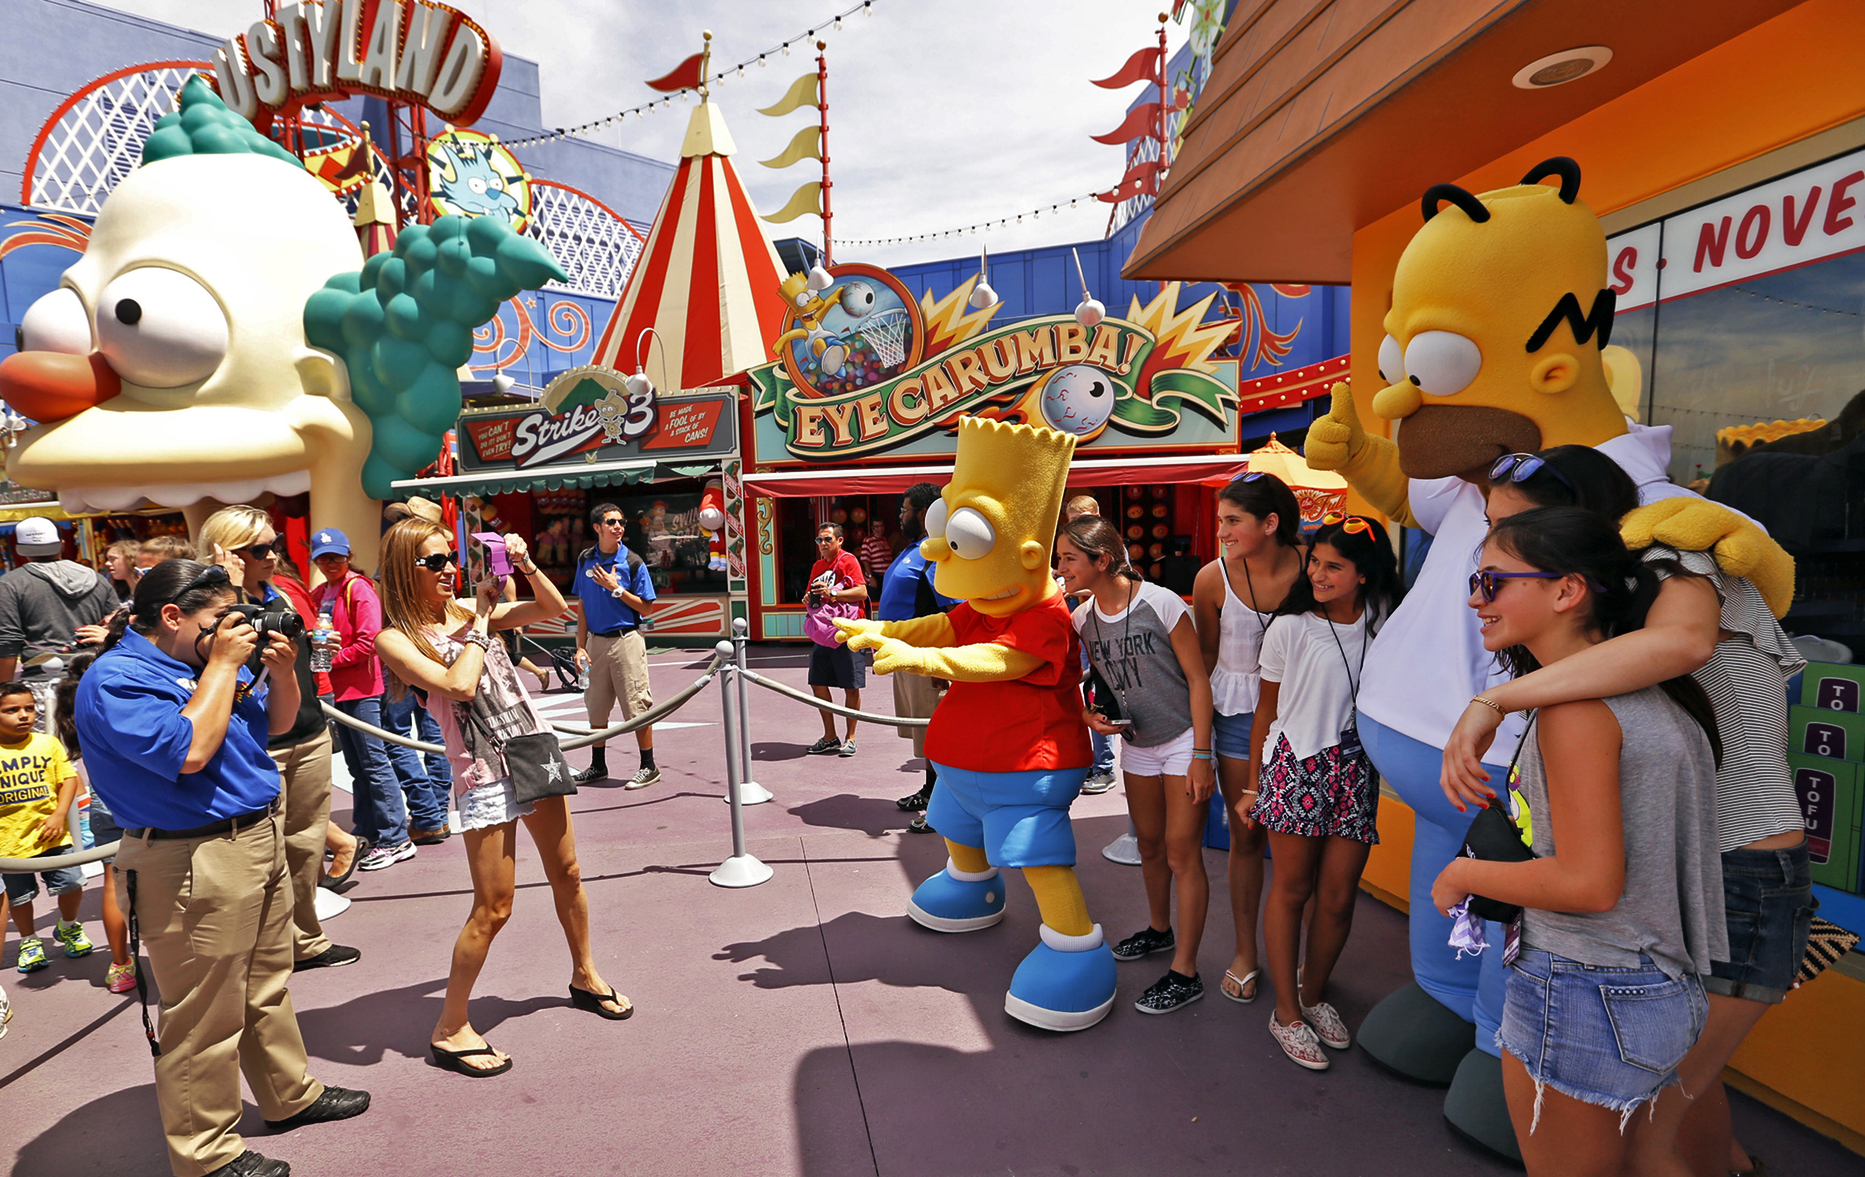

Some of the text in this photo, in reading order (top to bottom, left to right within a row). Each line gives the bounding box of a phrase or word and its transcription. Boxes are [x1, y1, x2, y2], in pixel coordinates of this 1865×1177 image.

[210, 0, 487, 119] USTYLAND
[793, 323, 1148, 446] EYE CARUMBA!
[669, 405, 694, 419] BE MADE
[669, 415, 688, 429] FOOL
[690, 415, 698, 423] OF
[698, 412, 707, 420] BY
[478, 421, 510, 441] YOU CAN'T
[511, 393, 654, 458] Strike 3
[675, 425, 692, 436] STACK
[692, 422, 700, 430] OF
[684, 427, 709, 443] CANS!
[482, 440, 511, 457] EVEN TRY!
[672, 507, 703, 531] SWIN
[1089, 632, 1156, 662] NEW YORK
[0, 756, 52, 774] MPLY
[1805, 776, 1821, 830] TOFU
